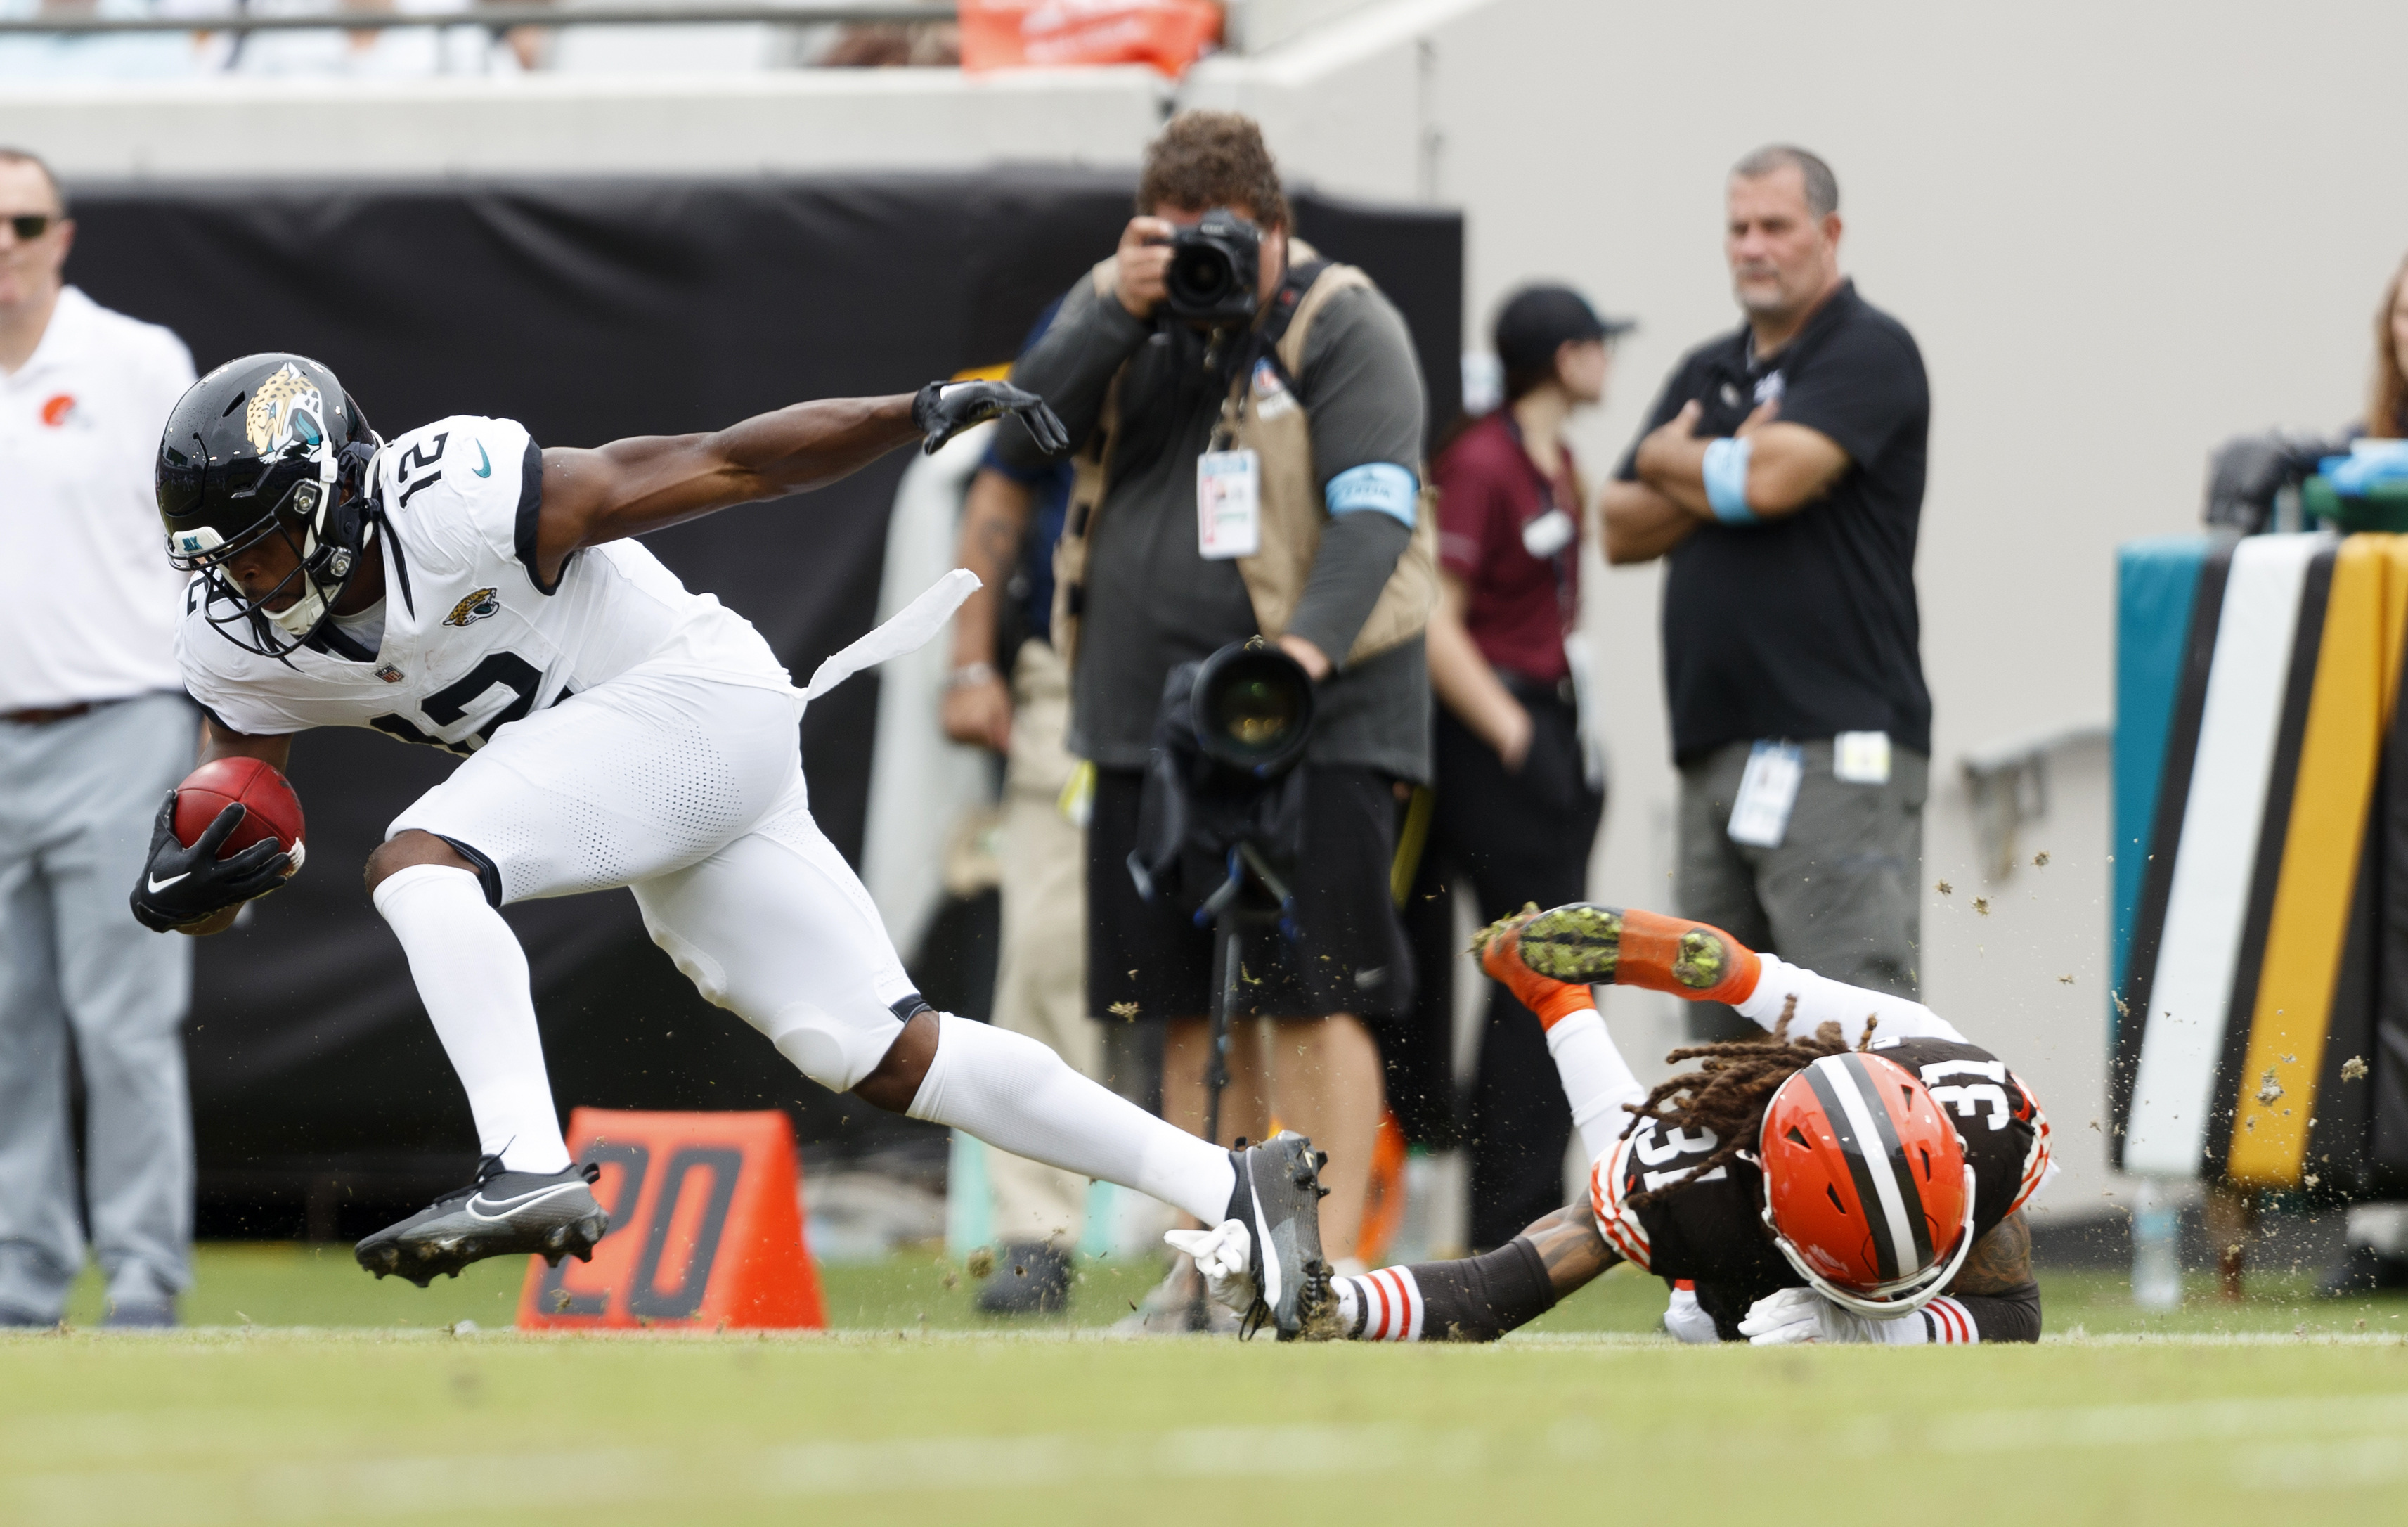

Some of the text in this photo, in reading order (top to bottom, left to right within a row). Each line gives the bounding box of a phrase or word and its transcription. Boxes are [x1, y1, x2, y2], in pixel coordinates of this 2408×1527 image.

[399, 432, 449, 509] 12
[1920, 1059, 2010, 1130] 31
[1635, 1126, 1728, 1193] 31
[538, 1142, 742, 1317] 20
